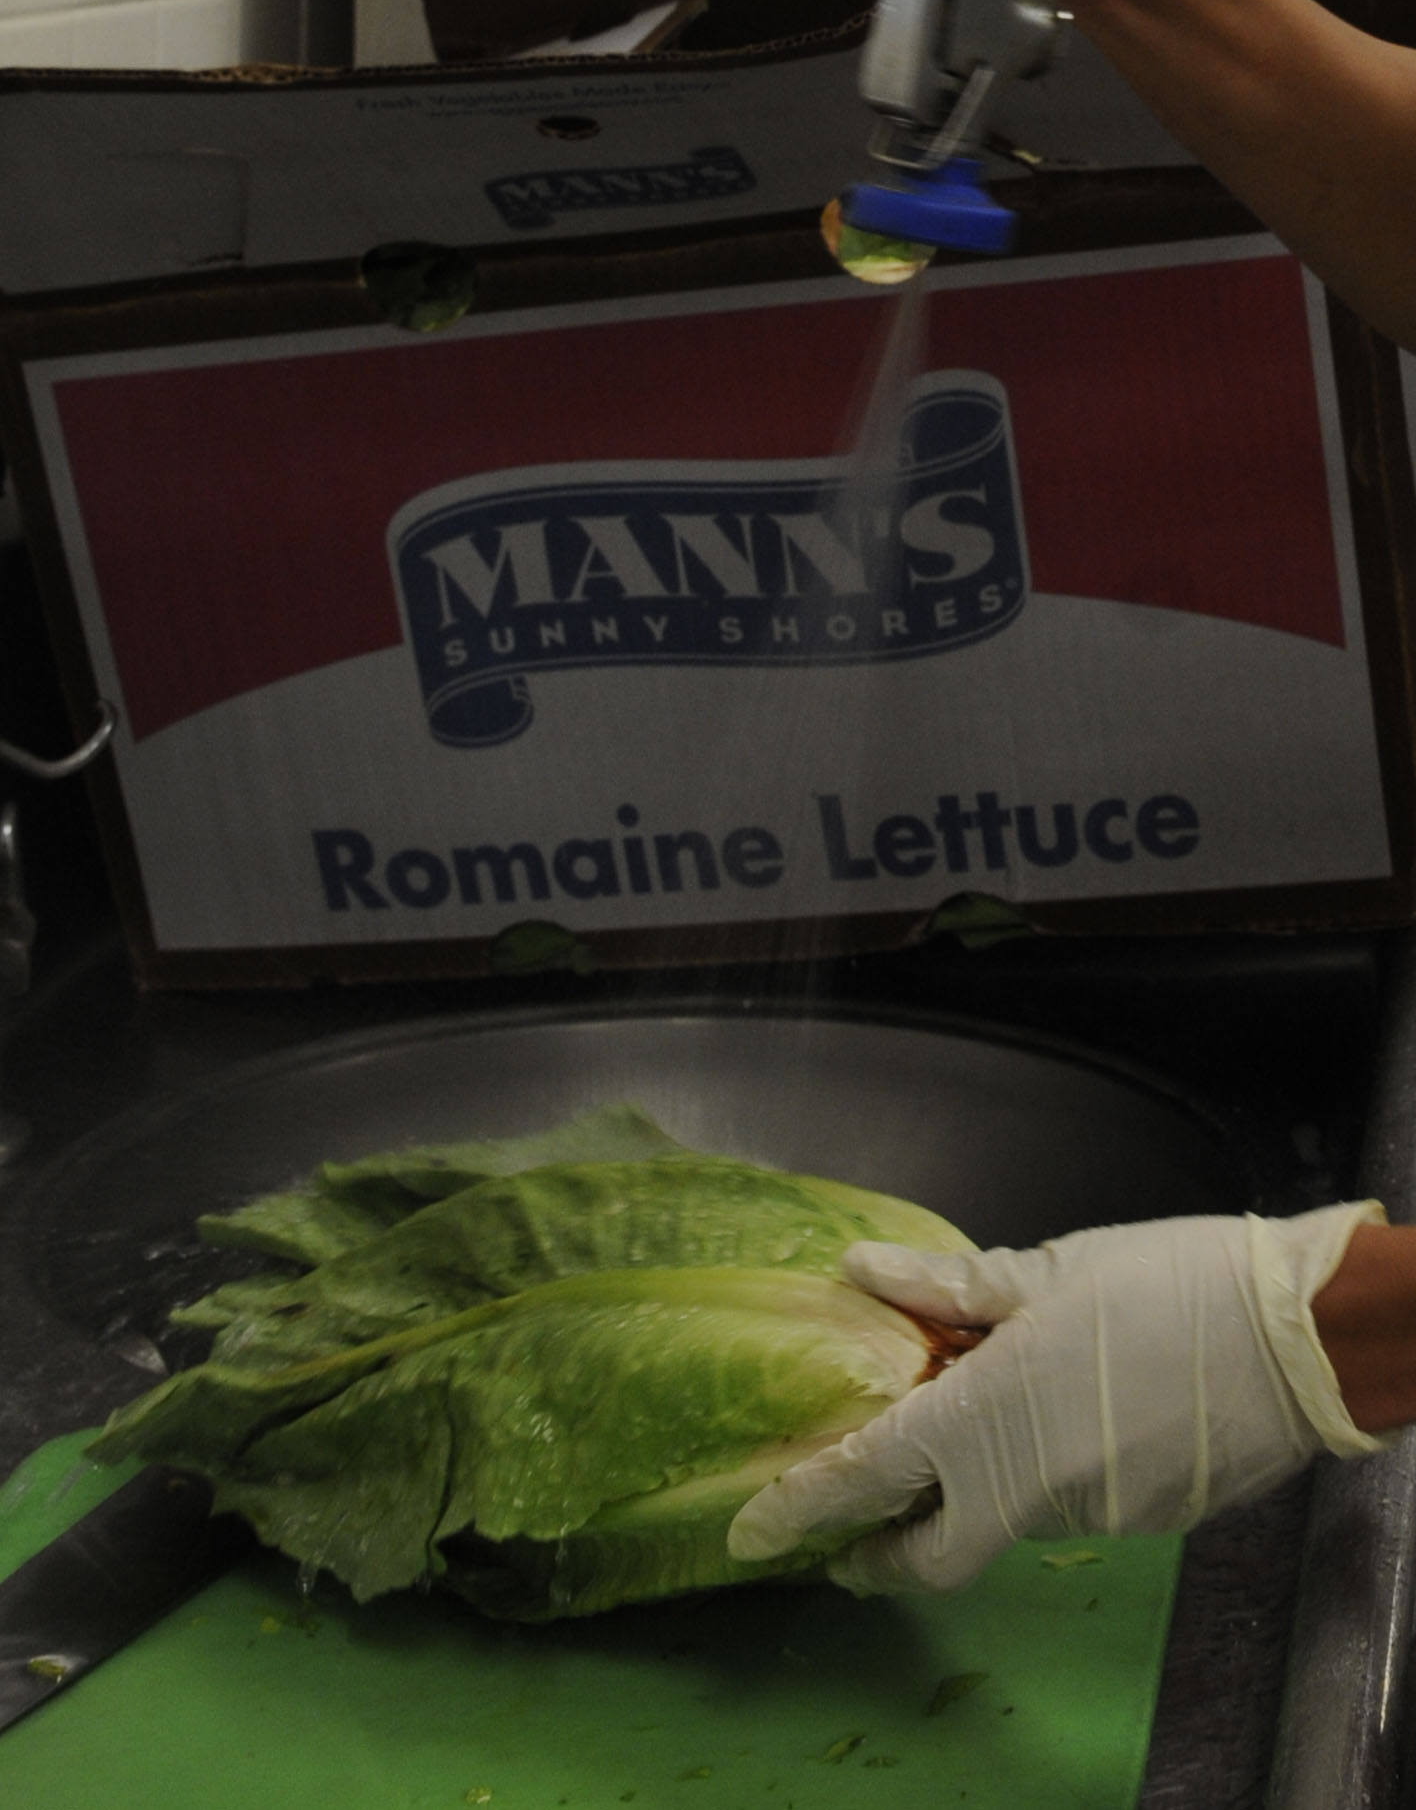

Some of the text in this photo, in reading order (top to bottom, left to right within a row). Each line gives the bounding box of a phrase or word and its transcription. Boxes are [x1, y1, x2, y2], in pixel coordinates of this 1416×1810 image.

[498, 166, 742, 198] MANN'S
[418, 484, 997, 631] MANN'S
[443, 616, 670, 668] SUNNY
[310, 791, 1201, 912] Romaine Lettuce
